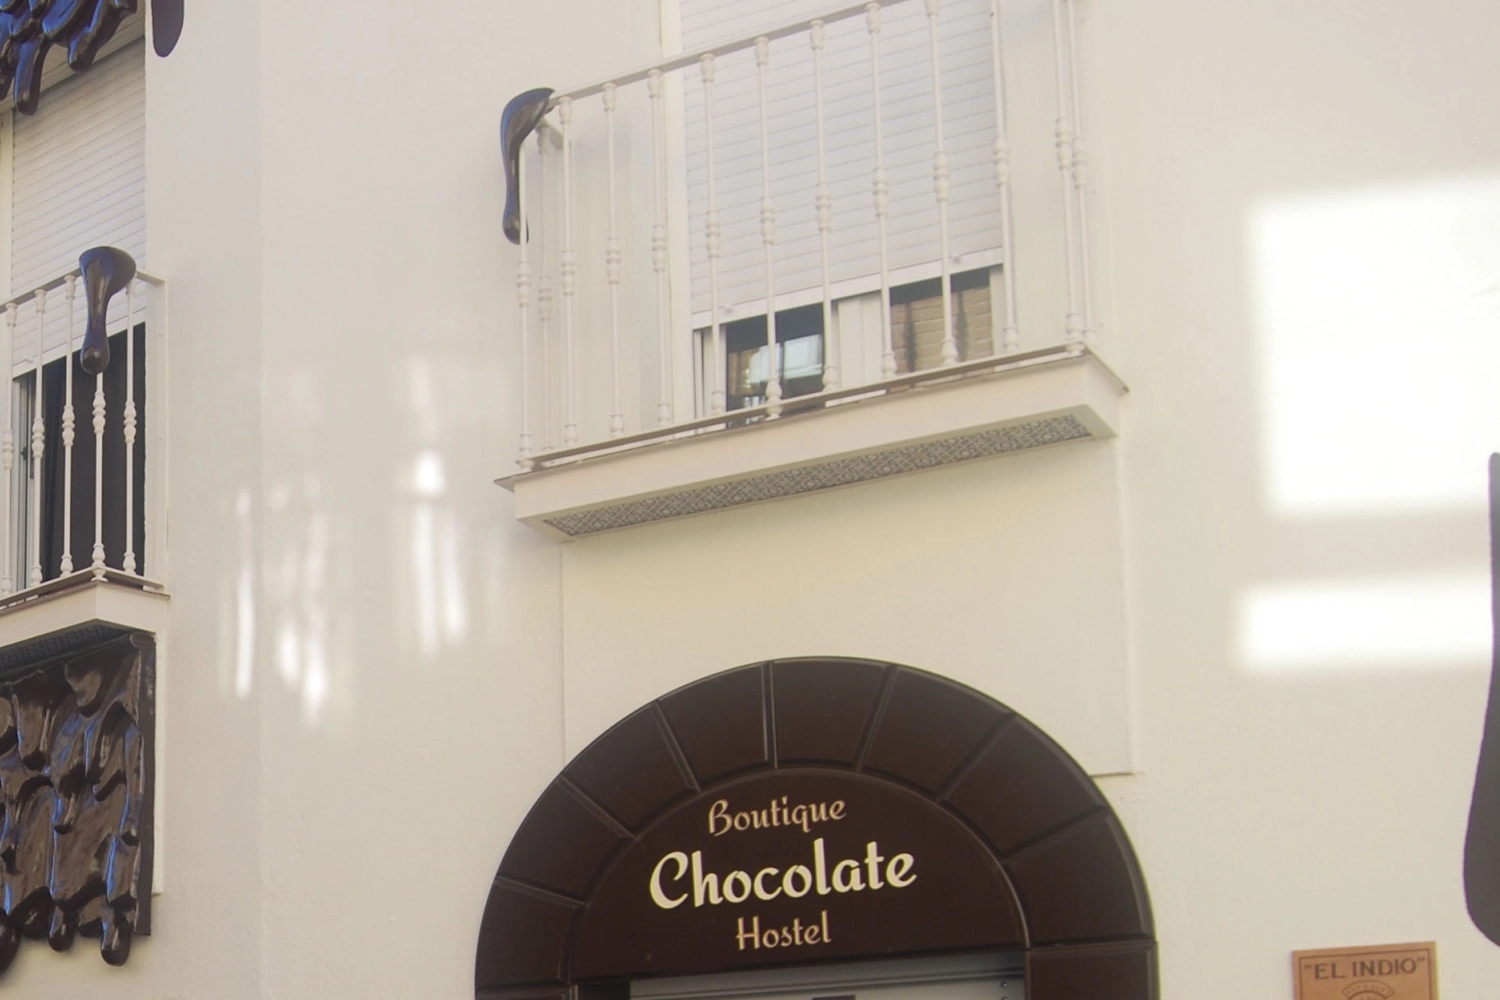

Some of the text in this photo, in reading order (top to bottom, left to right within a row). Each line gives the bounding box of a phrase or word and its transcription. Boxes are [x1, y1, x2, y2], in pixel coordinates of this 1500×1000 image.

[708, 795, 847, 837] Boutique
[649, 837, 917, 910] Chocolate
[736, 909, 832, 950] Hostel
